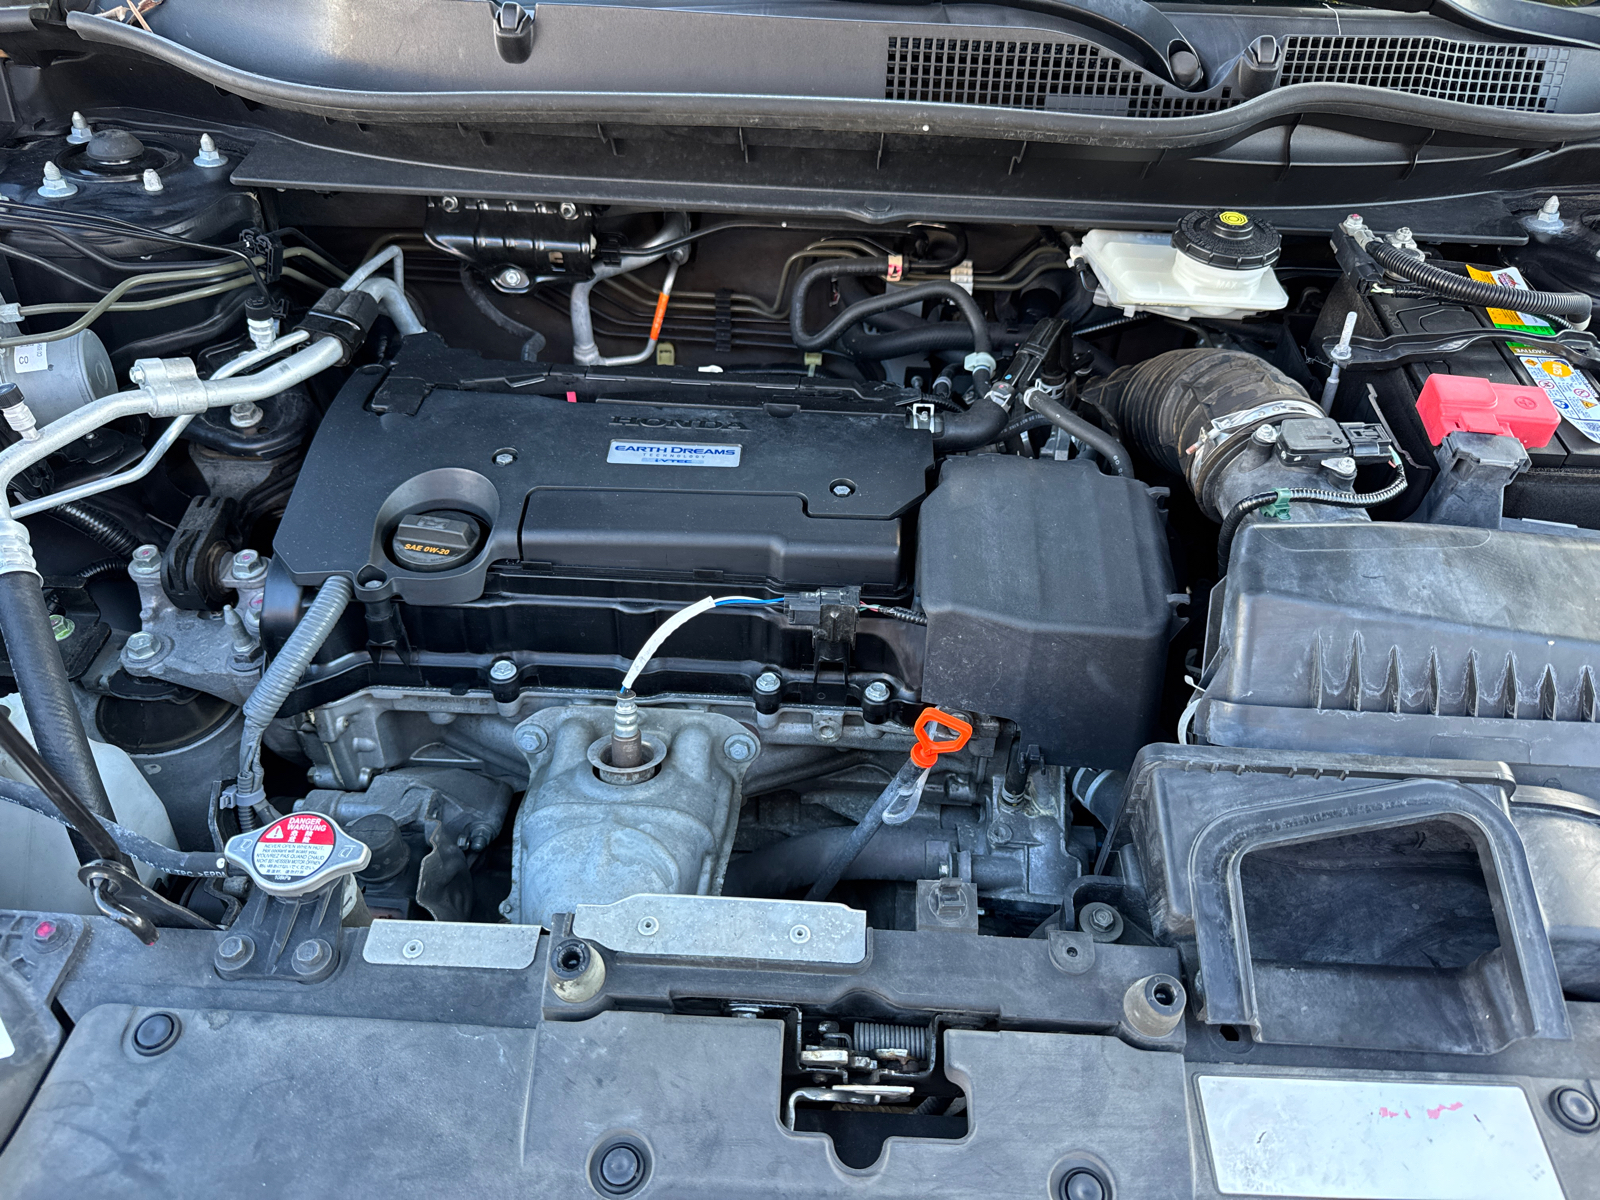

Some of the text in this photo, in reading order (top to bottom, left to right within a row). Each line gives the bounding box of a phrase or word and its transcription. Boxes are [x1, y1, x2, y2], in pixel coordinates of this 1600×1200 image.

[1215, 280, 1238, 289] MAX
[609, 416, 752, 431] HONDA
[615, 445, 736, 456] EARTH DREAMS
[404, 543, 451, 555] SAE 0W-20
[287, 823, 327, 832] WARNUNG
